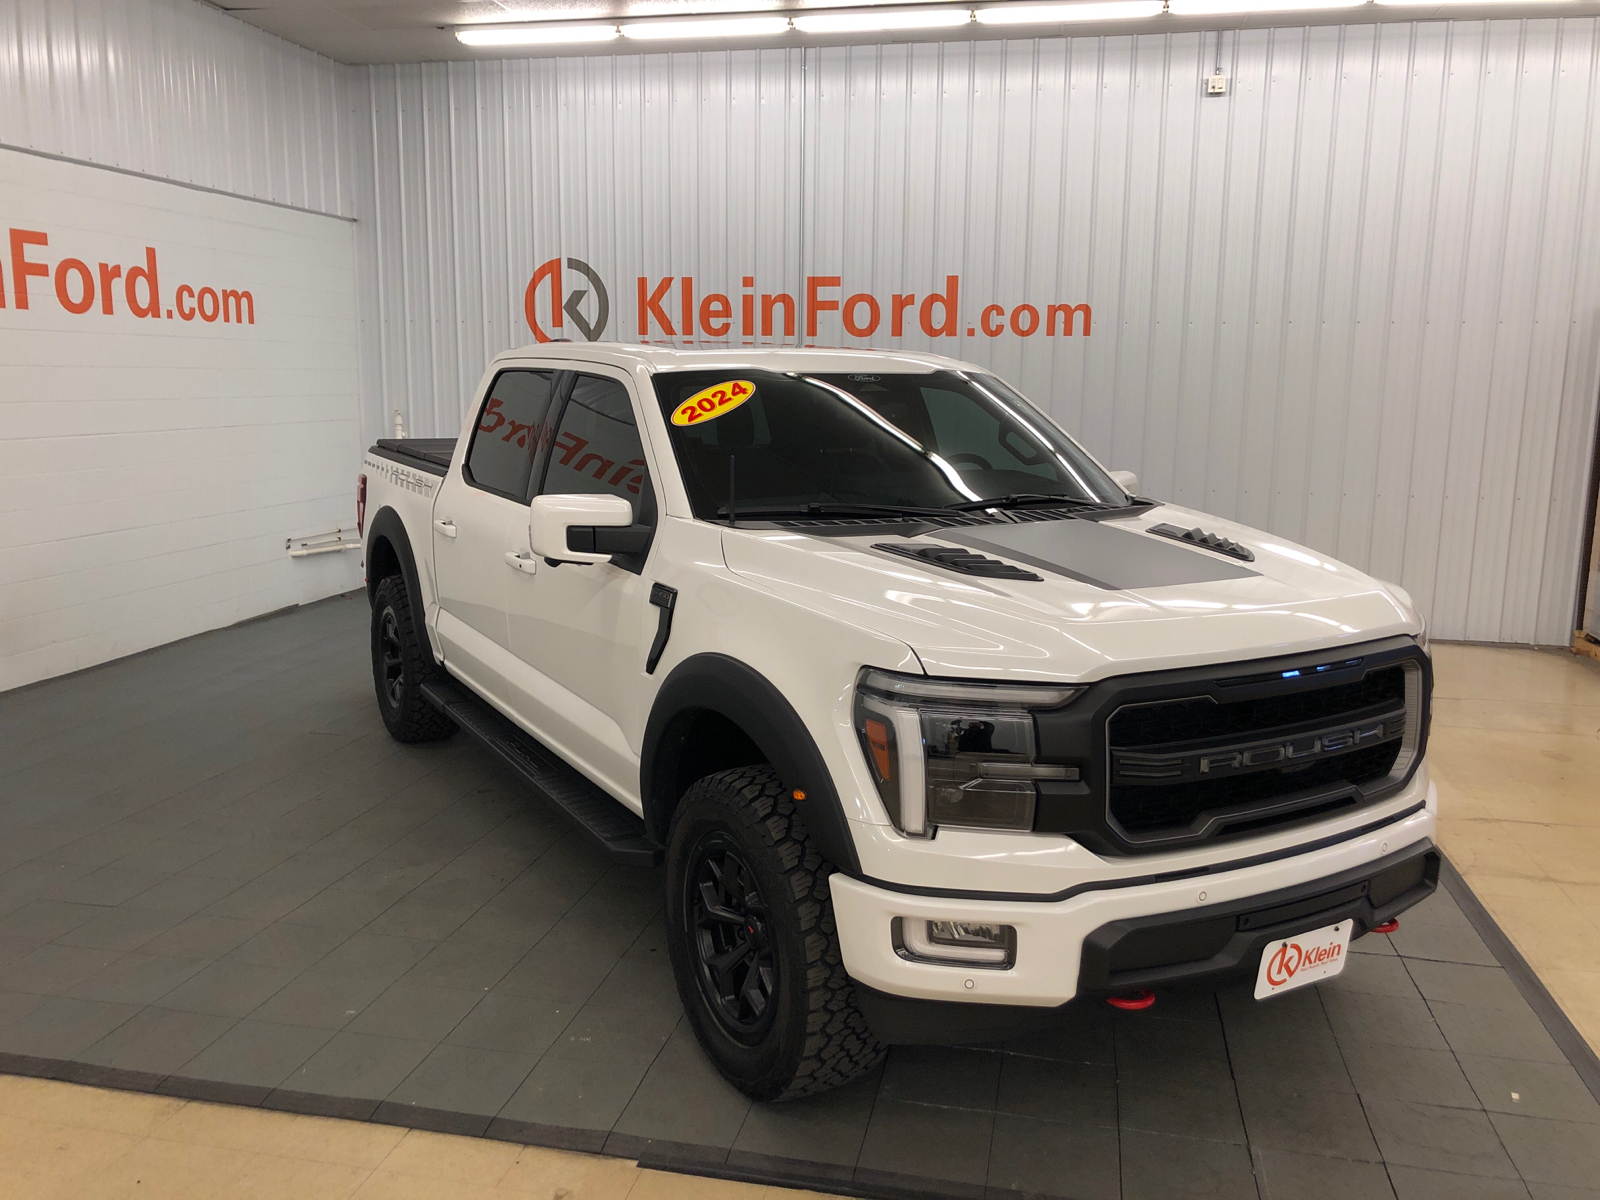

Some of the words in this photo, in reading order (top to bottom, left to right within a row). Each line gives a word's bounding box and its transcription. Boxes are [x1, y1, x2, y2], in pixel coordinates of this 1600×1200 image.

[0, 227, 255, 325] Ford.com
[637, 275, 1092, 338] KleinFord.com
[680, 382, 748, 422] 2024
[1200, 724, 1385, 773] ROUSH
[1302, 942, 1342, 967] Klein
